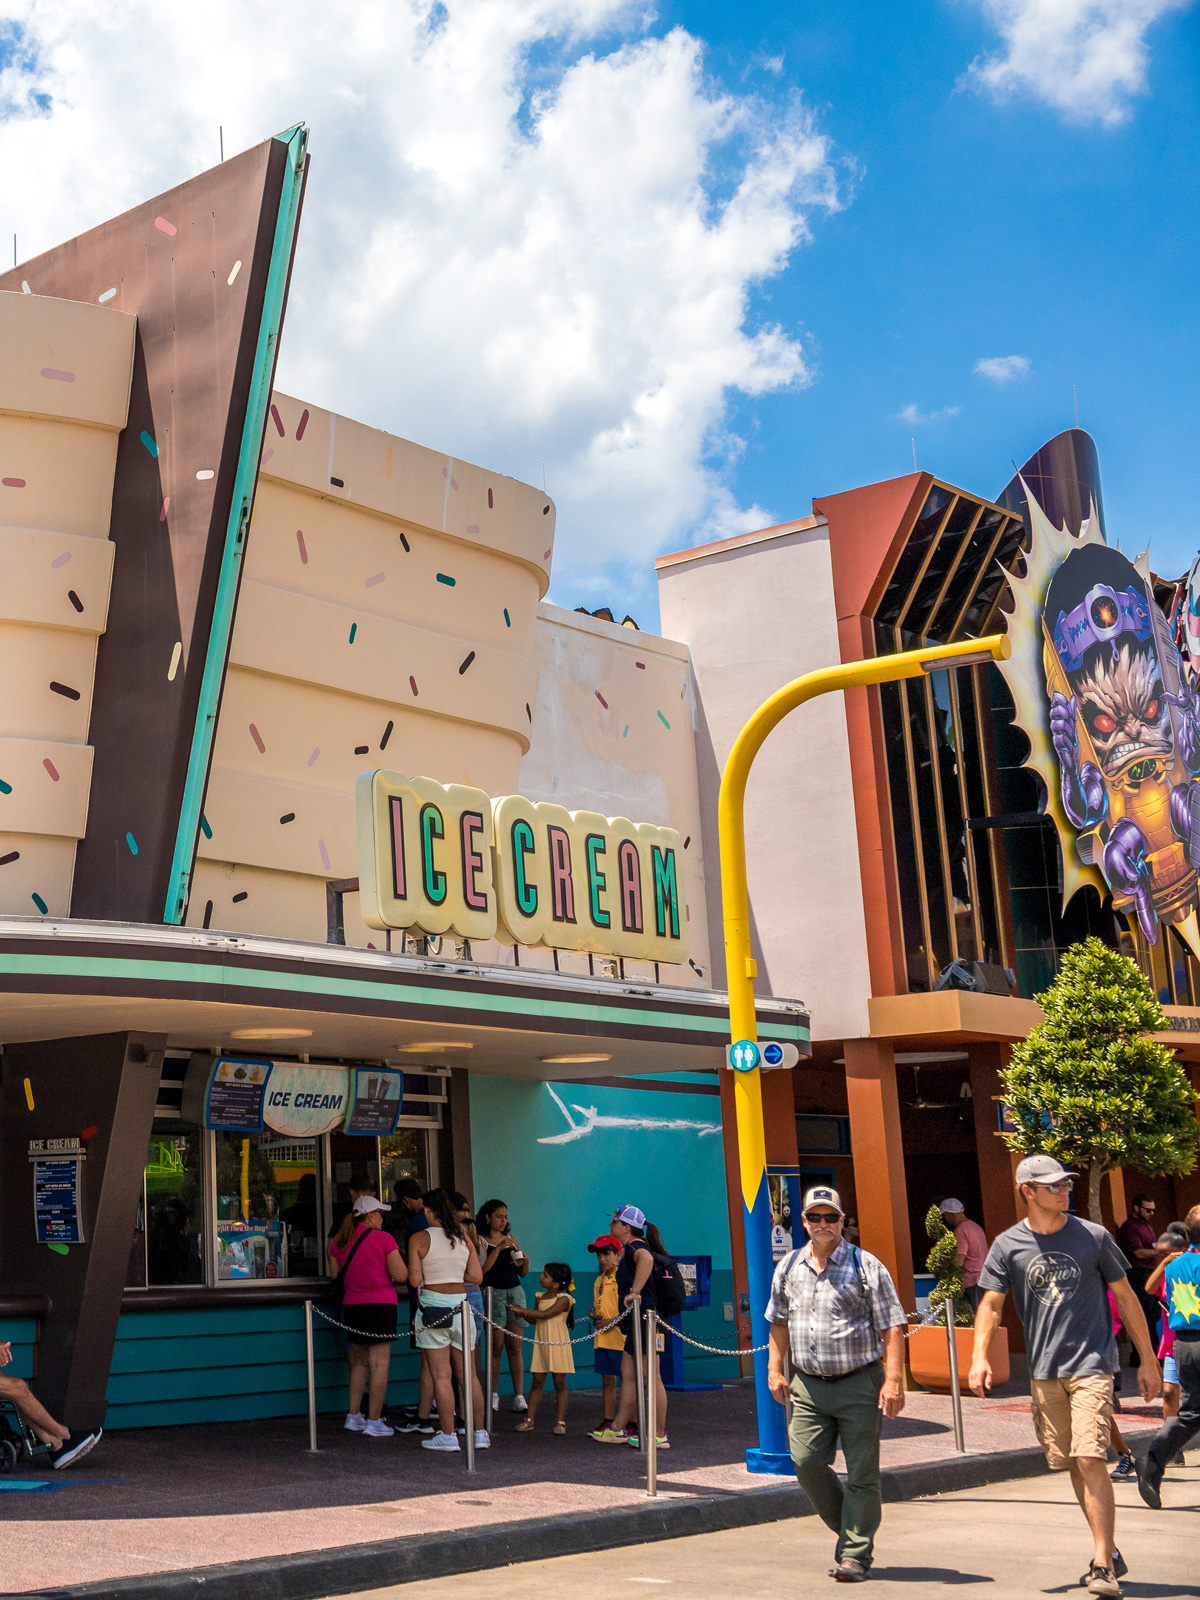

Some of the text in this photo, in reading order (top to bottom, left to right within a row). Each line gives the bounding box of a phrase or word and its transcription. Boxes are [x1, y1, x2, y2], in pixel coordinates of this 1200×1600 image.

[388, 794, 681, 940] ICE CREAM
[267, 1091, 291, 1107] ICE
[293, 1093, 343, 1110] CREAM
[30, 1137, 80, 1150] ICE CREAM
[217, 1225, 229, 1233] efill
[1029, 1264, 1078, 1288] Bauer
